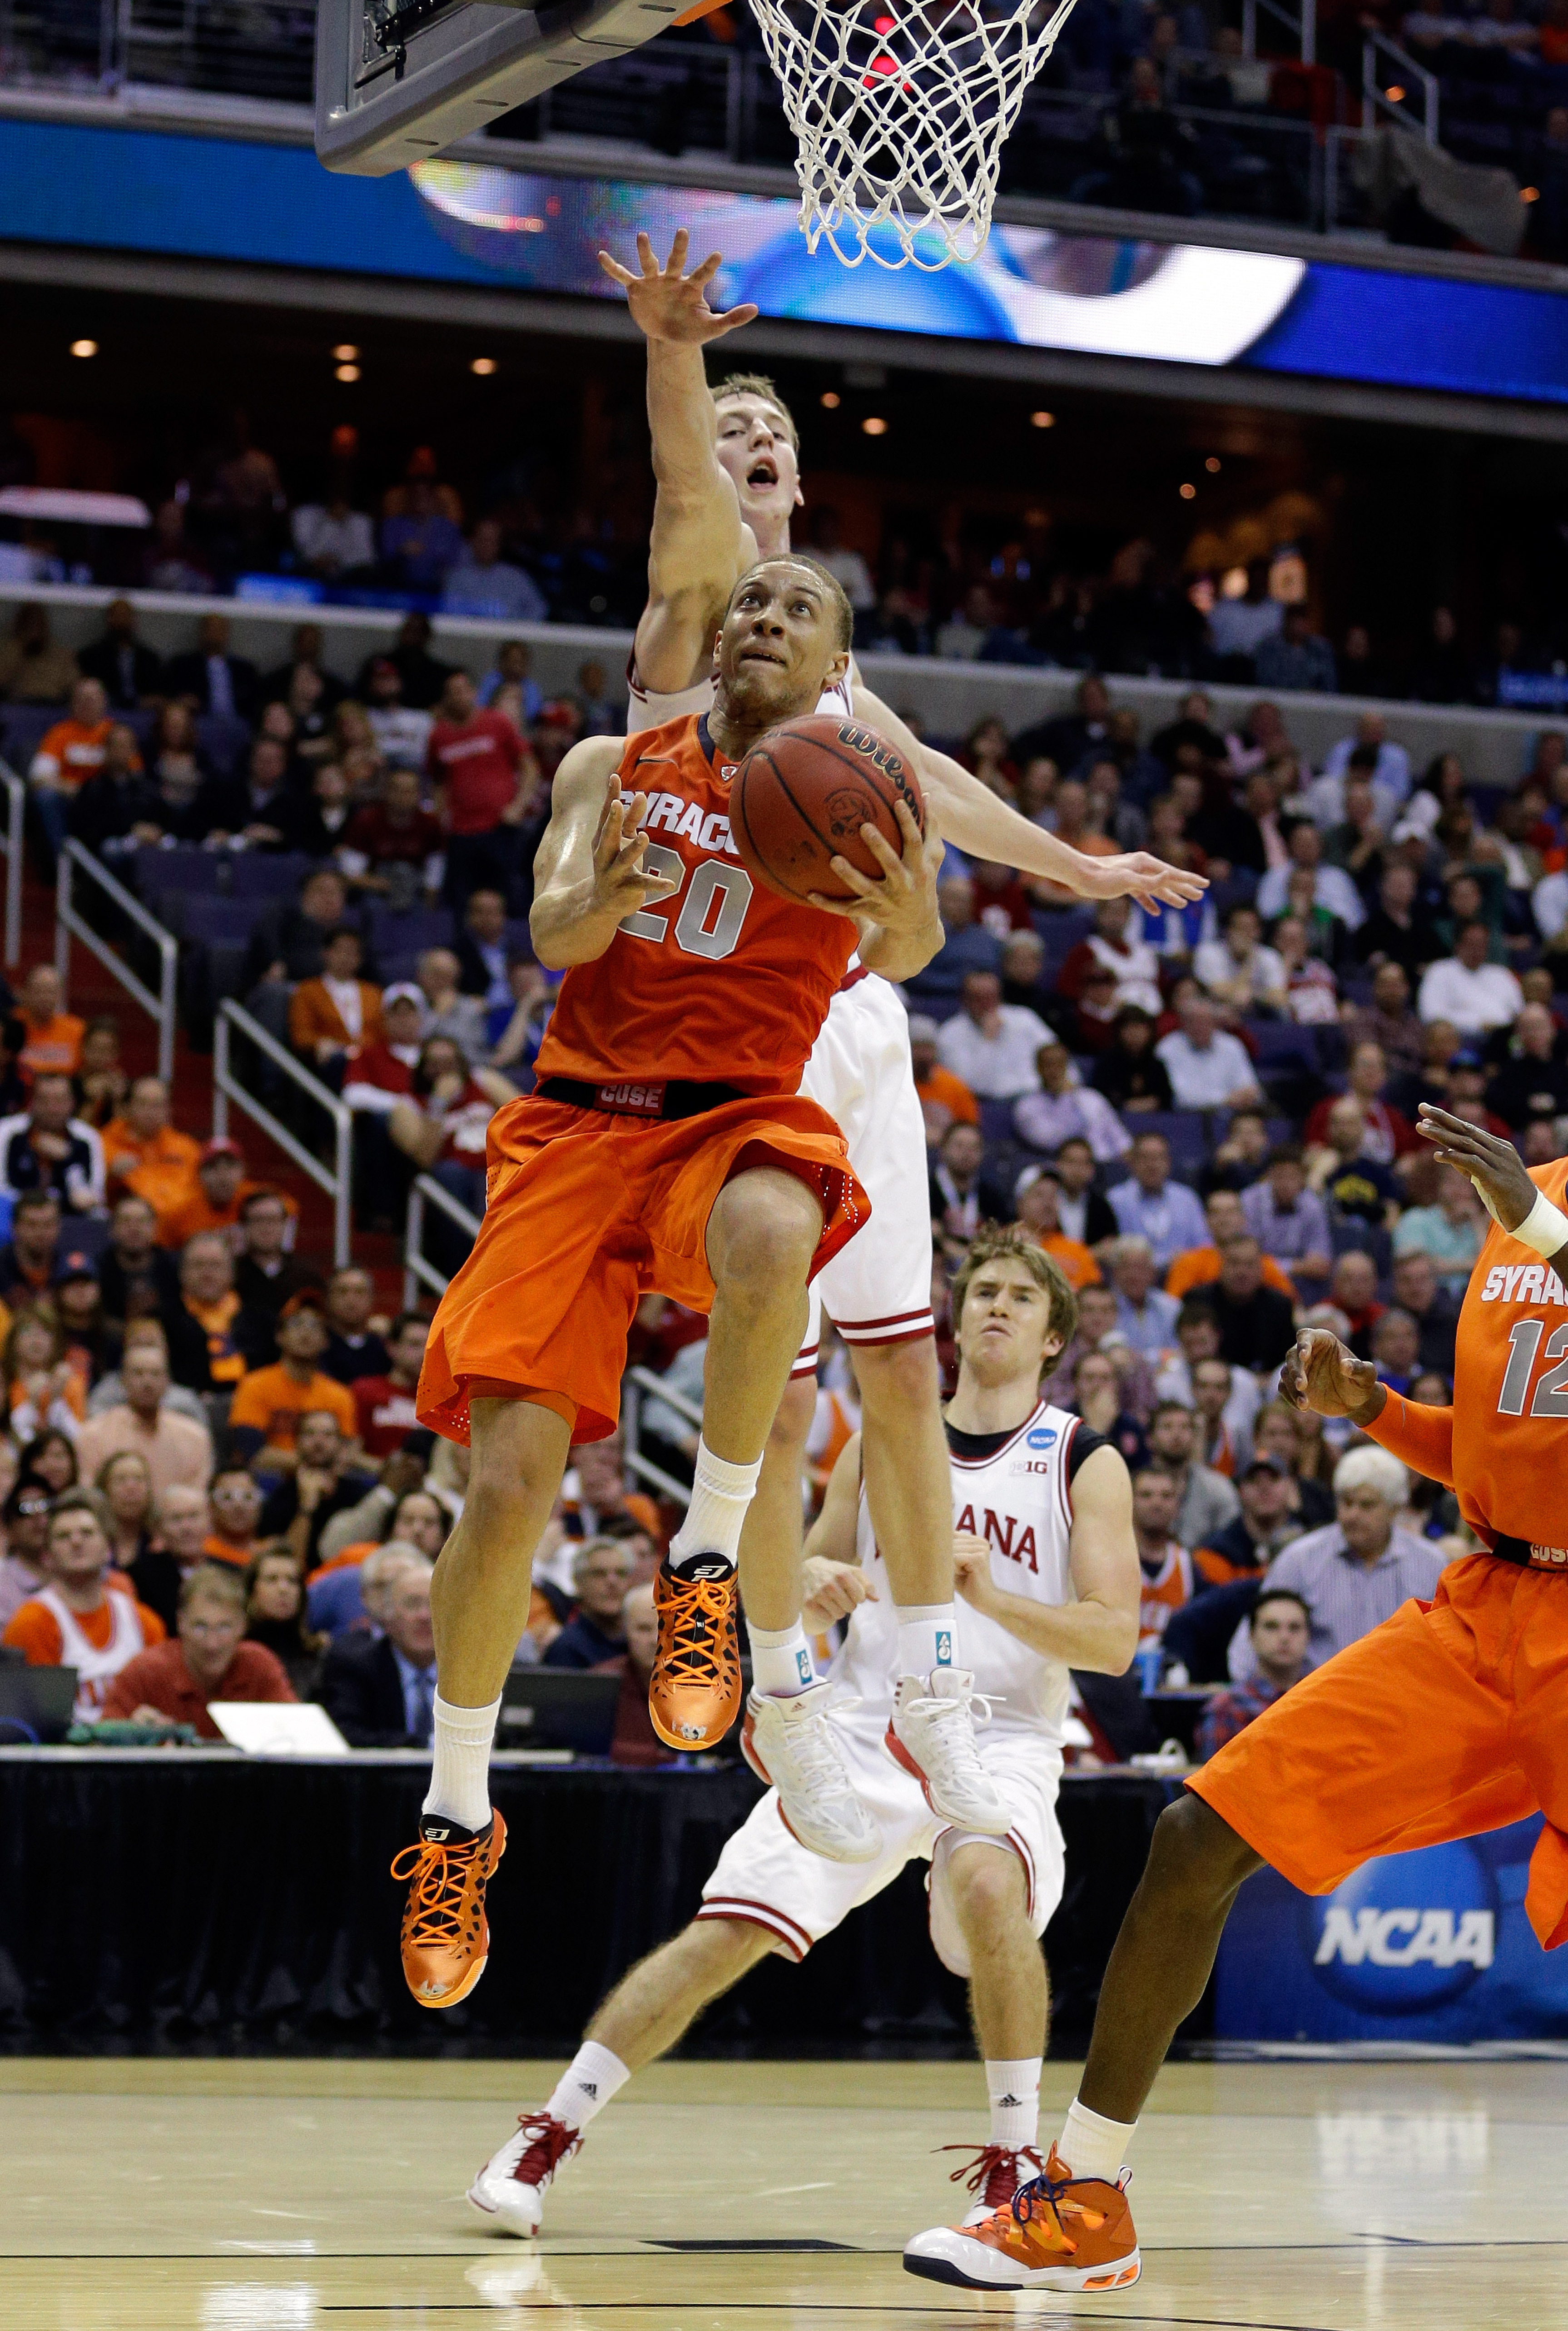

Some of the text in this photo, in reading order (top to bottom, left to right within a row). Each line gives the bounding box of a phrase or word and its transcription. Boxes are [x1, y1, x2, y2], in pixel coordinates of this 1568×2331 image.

[618, 842, 754, 961] 20
[601, 1084, 662, 1108] CUSE
[1481, 1265, 1568, 1308] SYRA
[955, 1504, 1039, 1575] ANA
[1529, 1543, 1568, 1562] CUS
[1314, 1908, 1495, 1970] NCAA
